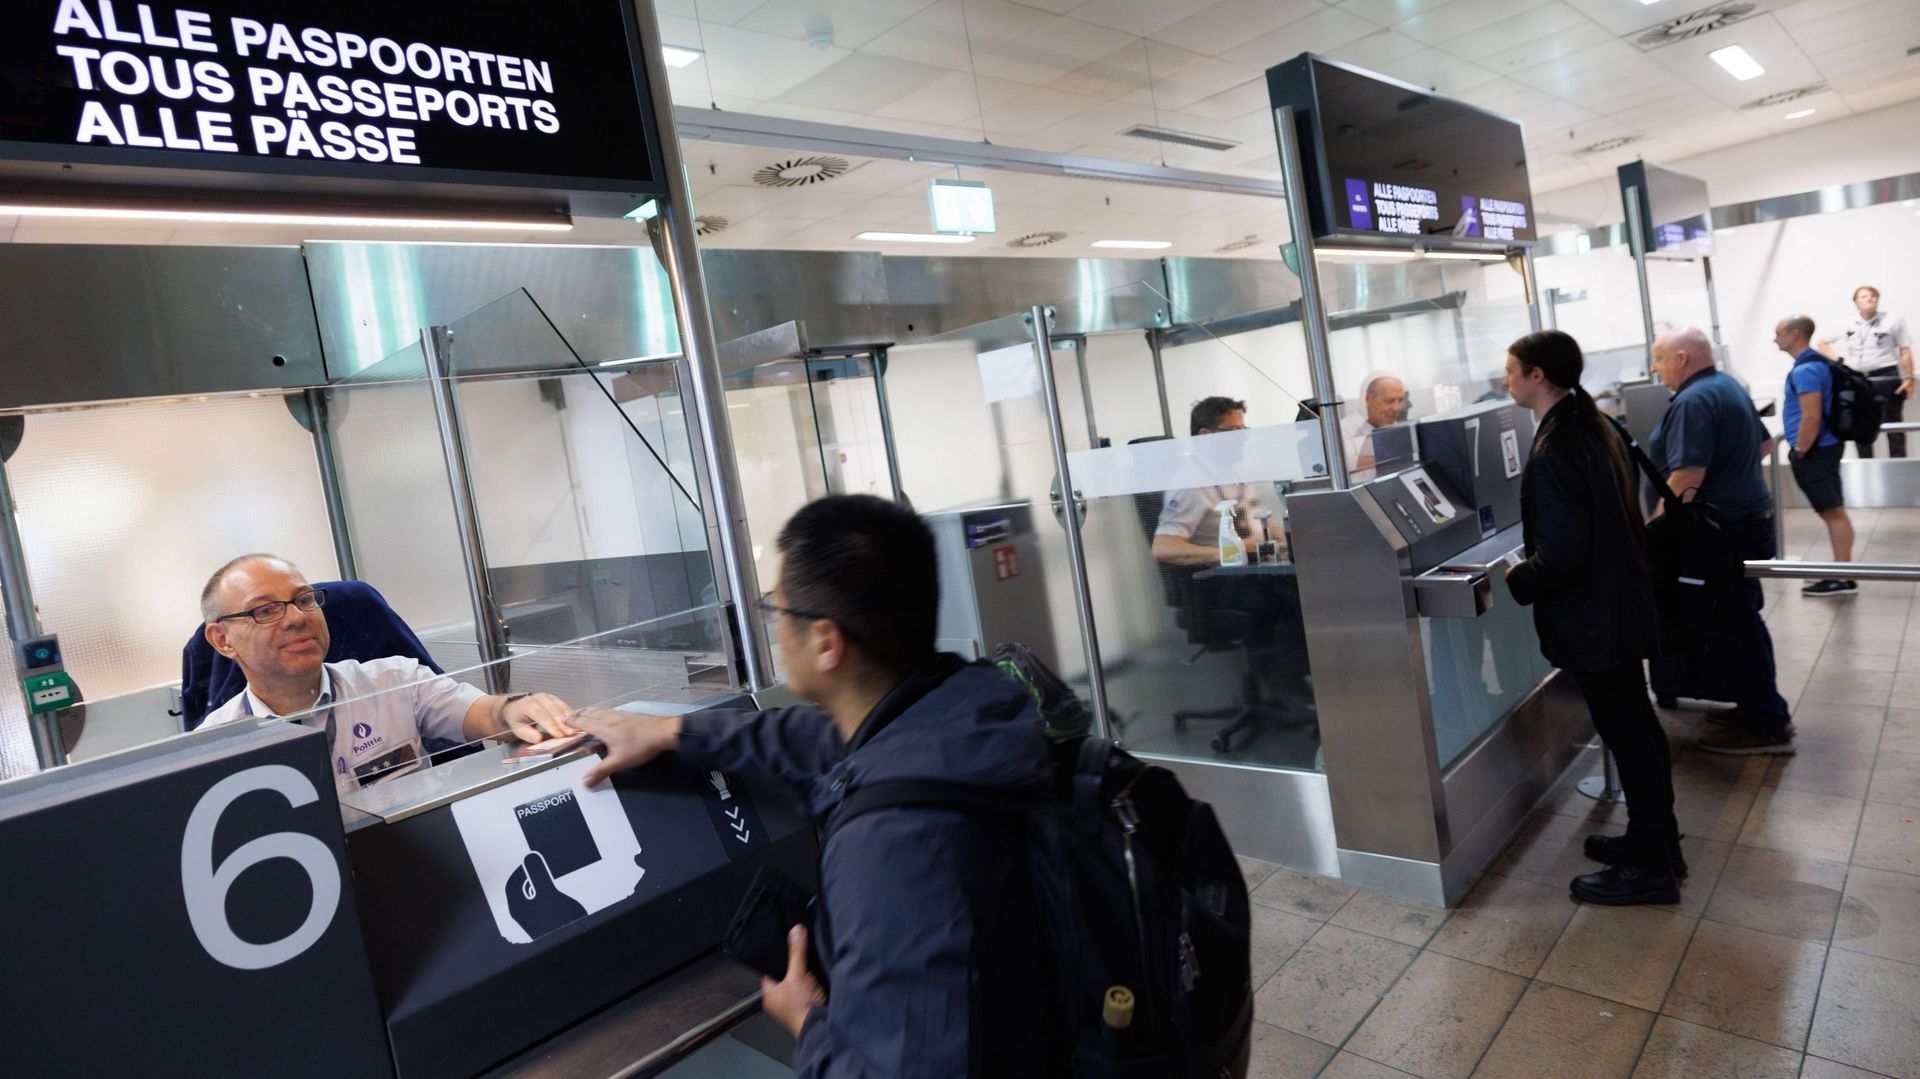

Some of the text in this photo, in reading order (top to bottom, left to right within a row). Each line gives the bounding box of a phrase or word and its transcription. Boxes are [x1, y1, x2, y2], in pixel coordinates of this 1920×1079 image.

[54, 0, 553, 93] ALLE PASPOORTEN
[57, 45, 559, 133] TOUS PASSEPORTS
[77, 101, 420, 164] ALLE PÄSSE
[1373, 182, 1393, 199] ALLE
[1374, 199, 1396, 216] TOUS
[1378, 217, 1398, 232] ALLE
[1464, 417, 1480, 477] 7
[353, 735, 384, 754] Politie
[517, 791, 573, 819] PASSPORT
[181, 764, 340, 970] 6
